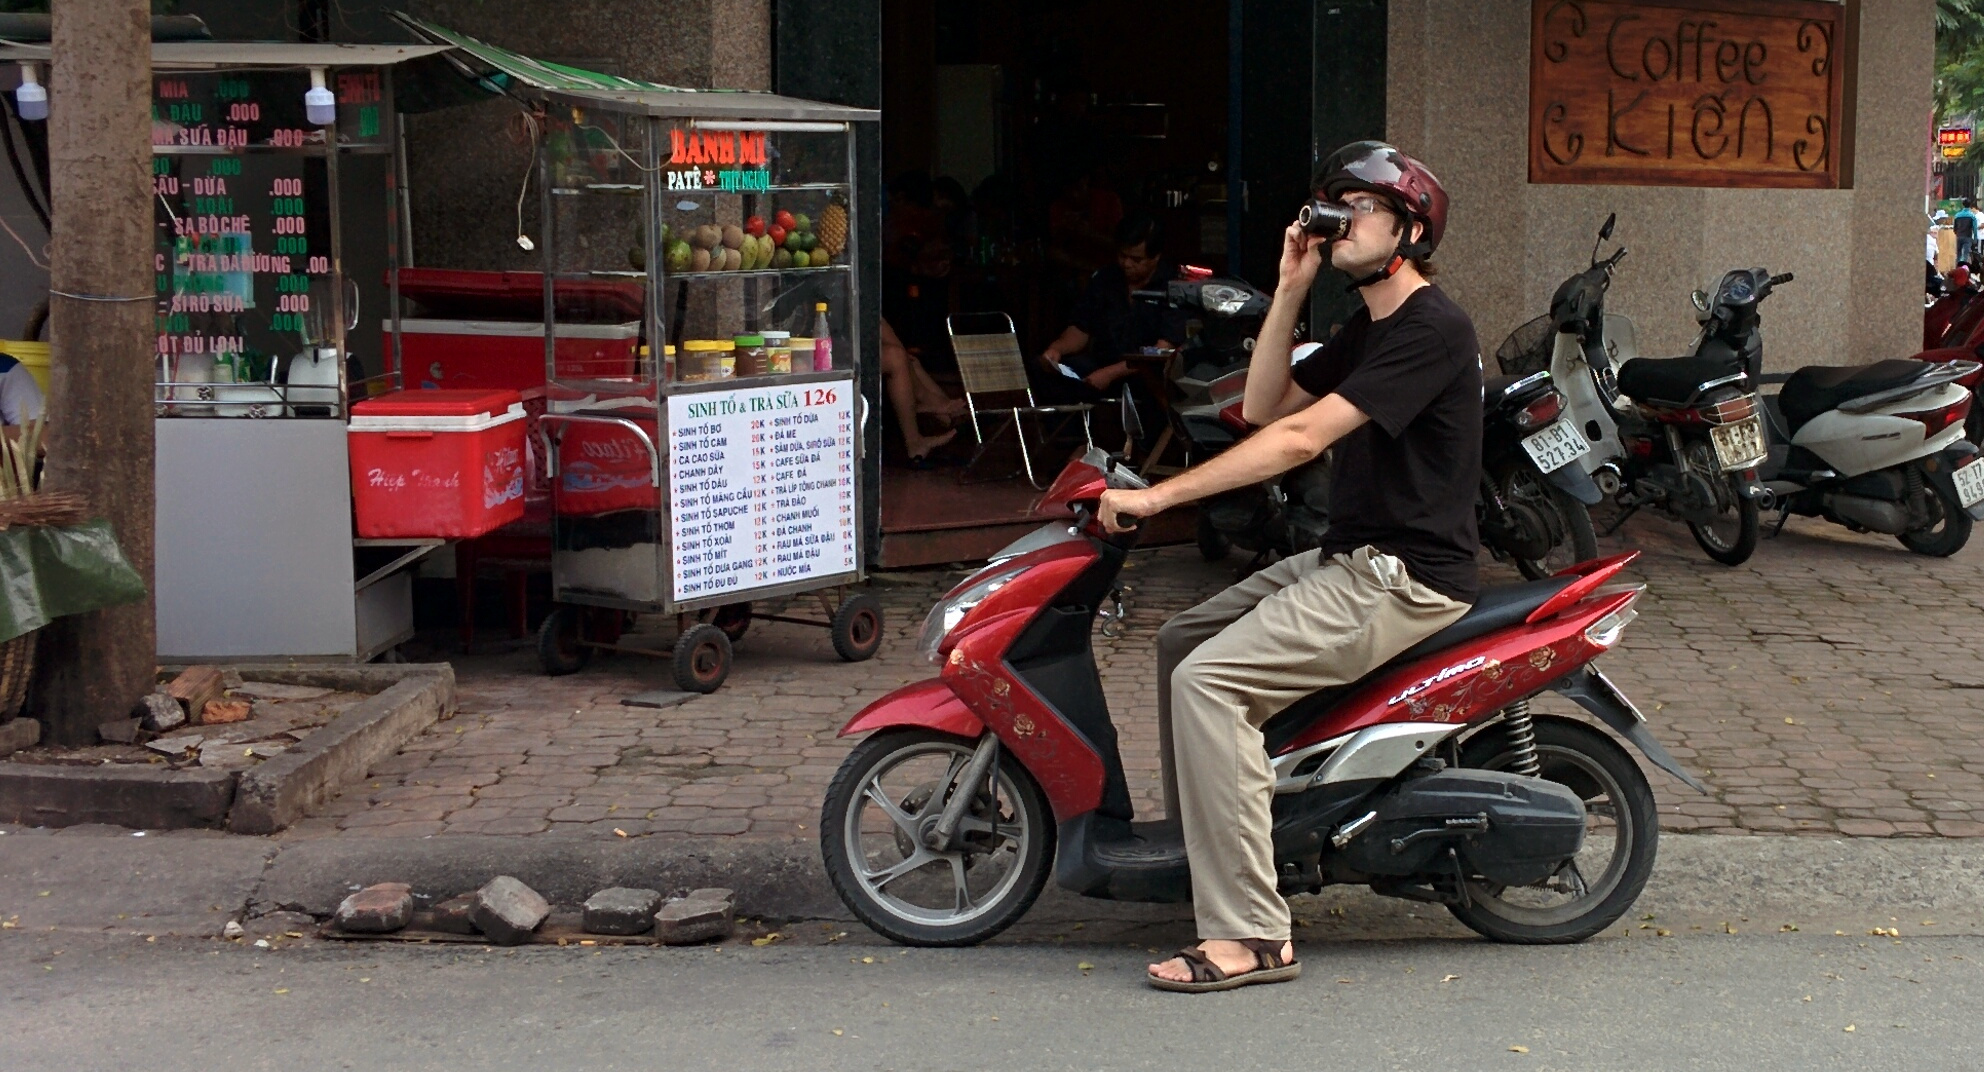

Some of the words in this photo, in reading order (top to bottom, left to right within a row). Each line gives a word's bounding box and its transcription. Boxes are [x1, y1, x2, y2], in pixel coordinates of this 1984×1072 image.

[1606, 14, 1768, 85] Coffee
[226, 103, 260, 121] .000
[270, 178, 303, 196] .000
[272, 215, 305, 234] .000
[276, 295, 309, 312] .000
[688, 401, 717, 418] SINH
[720, 392, 736, 414] TỐ
[749, 391, 773, 412] TRÀ
[776, 391, 798, 410] SỮA
[804, 387, 837, 407] 126
[774, 416, 791, 427] SINH
[678, 428, 697, 438] SINH
[678, 440, 697, 451] SINH
[710, 437, 728, 448] CAM
[678, 455, 690, 465] CA
[691, 453, 708, 464] CAO
[1537, 438, 1586, 470] 527.34
[775, 457, 794, 467] CAFE
[679, 467, 706, 480] CHANH
[679, 484, 698, 494] SINH
[680, 498, 698, 508] SINH
[680, 512, 699, 523] SINH
[712, 504, 749, 519] SAPUCHE
[776, 511, 801, 523] CHANH
[681, 526, 700, 537] SINH
[788, 523, 812, 535] CHANH
[681, 541, 701, 552] SINH
[682, 554, 701, 565] SINH
[683, 568, 702, 579] SINH
[731, 559, 753, 571] GANG
[683, 582, 702, 594] SINH
